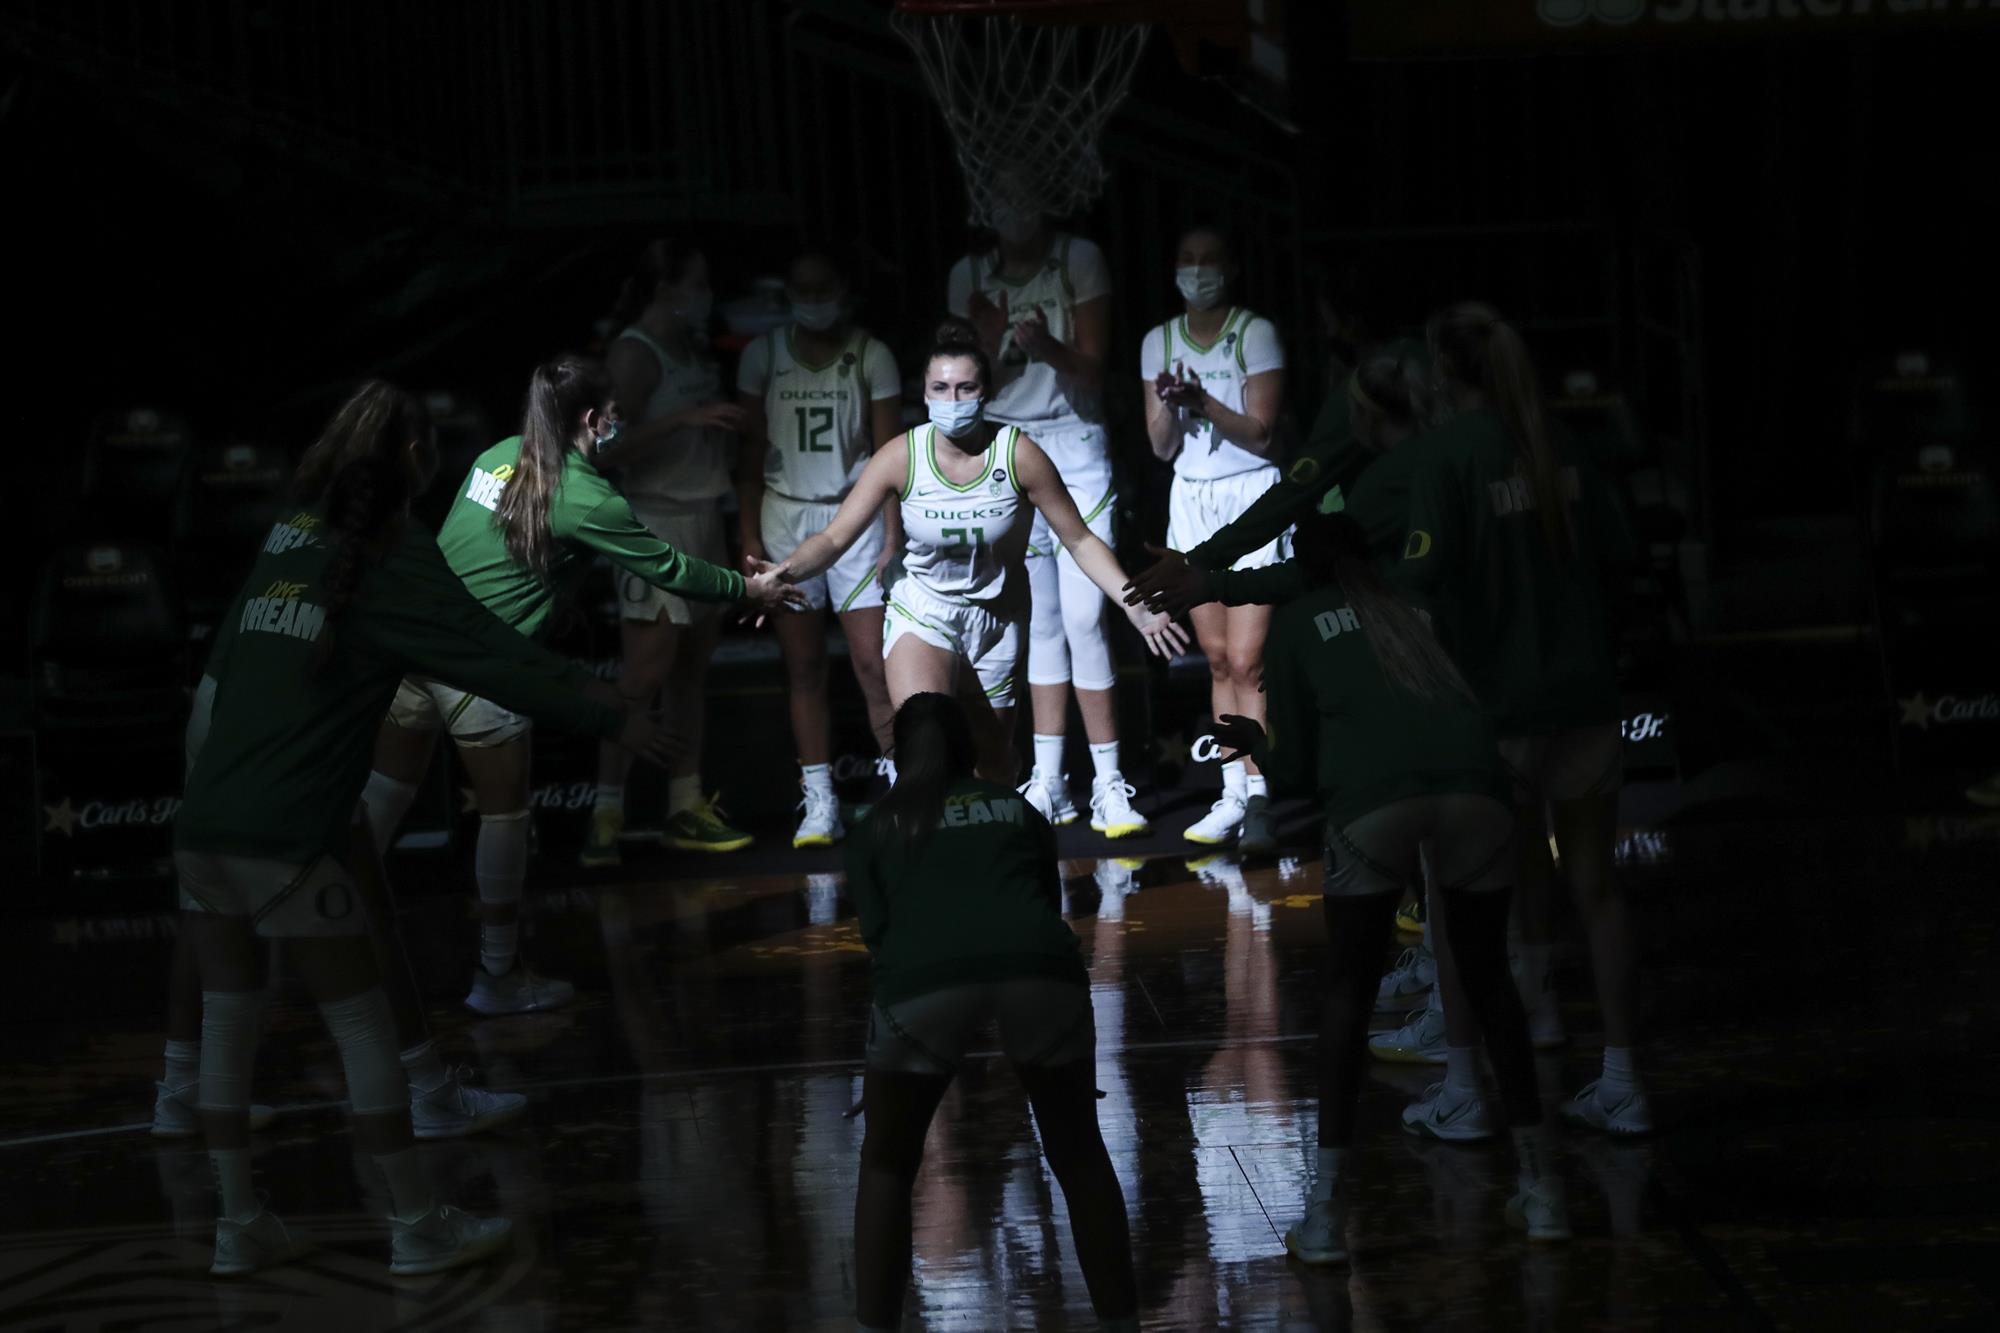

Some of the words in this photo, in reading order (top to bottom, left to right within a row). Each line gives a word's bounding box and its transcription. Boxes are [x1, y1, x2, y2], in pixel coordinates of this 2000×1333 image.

[780, 391, 849, 400] DUCKS
[796, 407, 834, 452] 12
[925, 508, 1003, 520] DUCKS
[942, 527, 985, 564] 21
[265, 580, 309, 599] ONE
